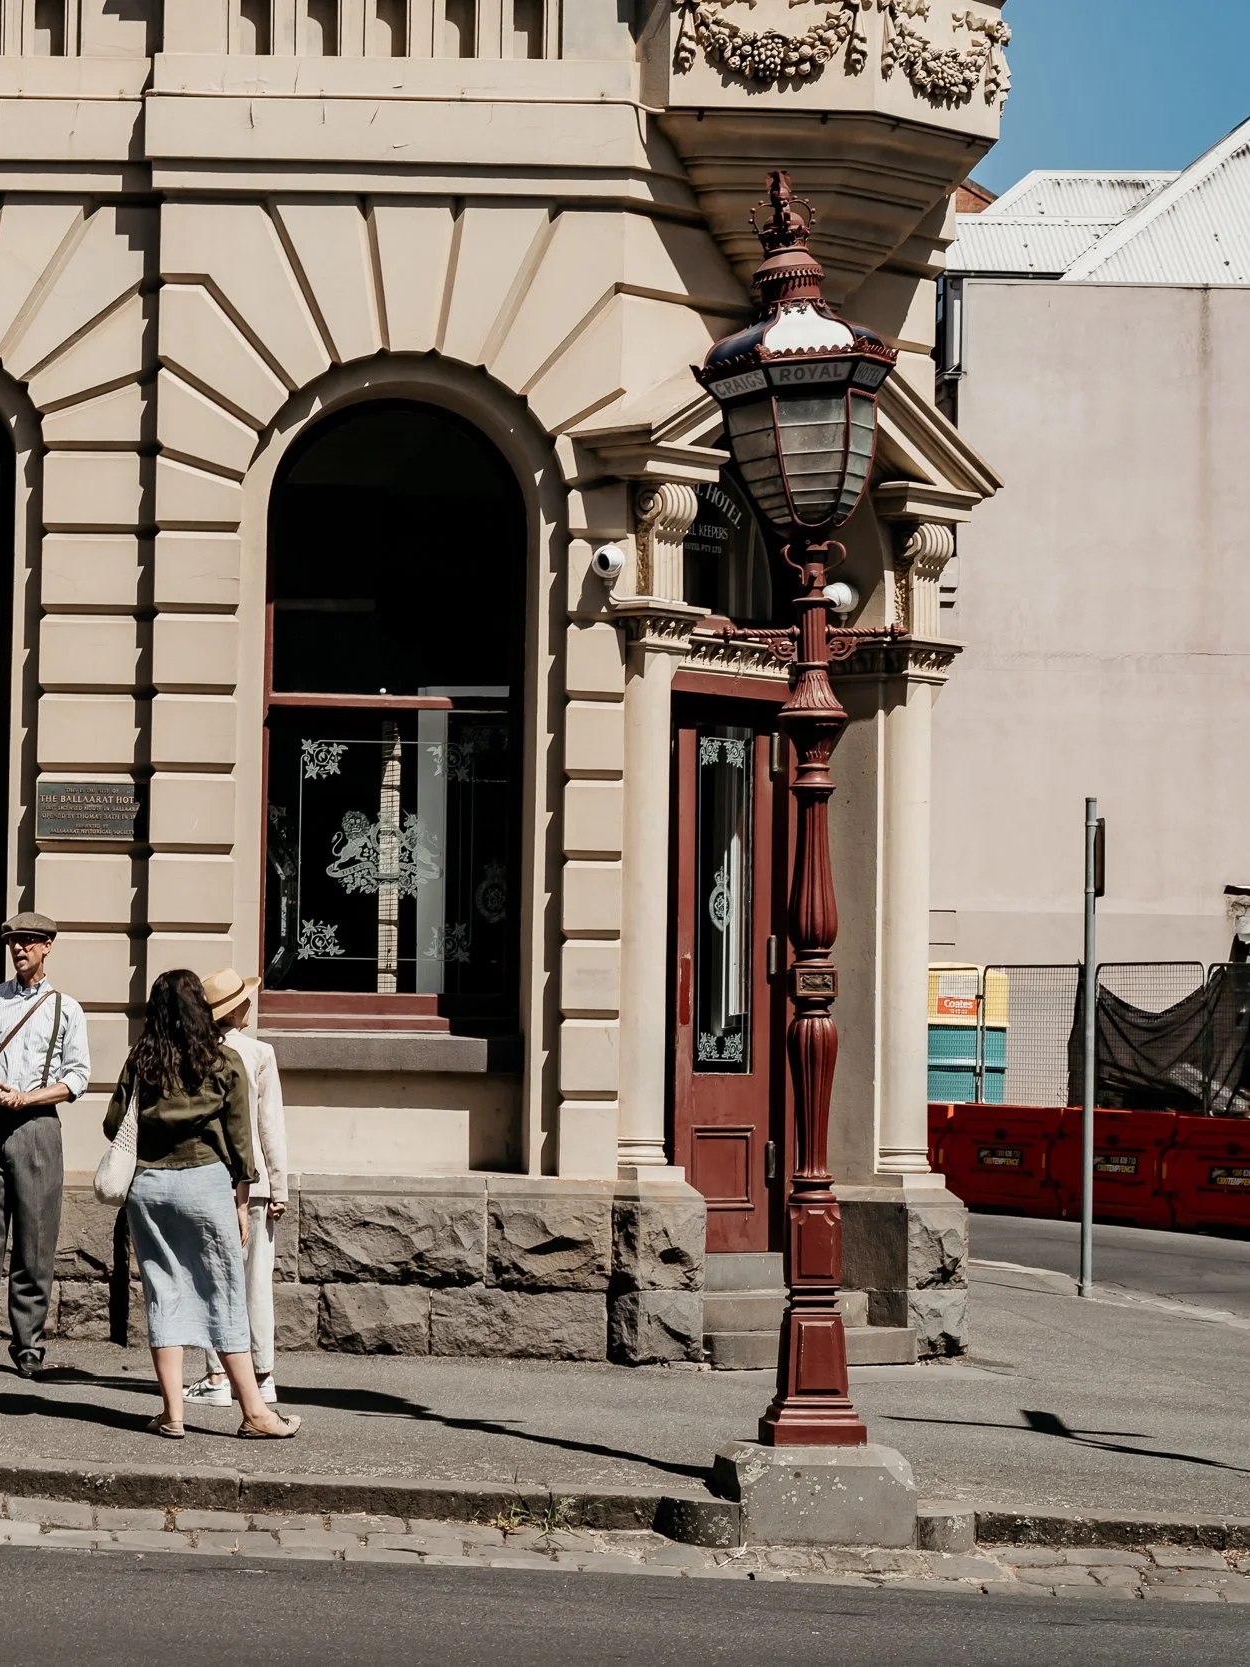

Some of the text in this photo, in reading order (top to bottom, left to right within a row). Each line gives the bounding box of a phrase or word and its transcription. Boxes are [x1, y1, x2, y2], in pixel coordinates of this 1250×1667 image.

[779, 367, 843, 382] ROYAL
[855, 364, 883, 384] HOTEL
[705, 484, 743, 530] HOTEL
[699, 524, 729, 540] KEEPERS
[39, 794, 59, 803] THE
[60, 795, 113, 804] BALLAARAT
[943, 999, 974, 1009] Coates
